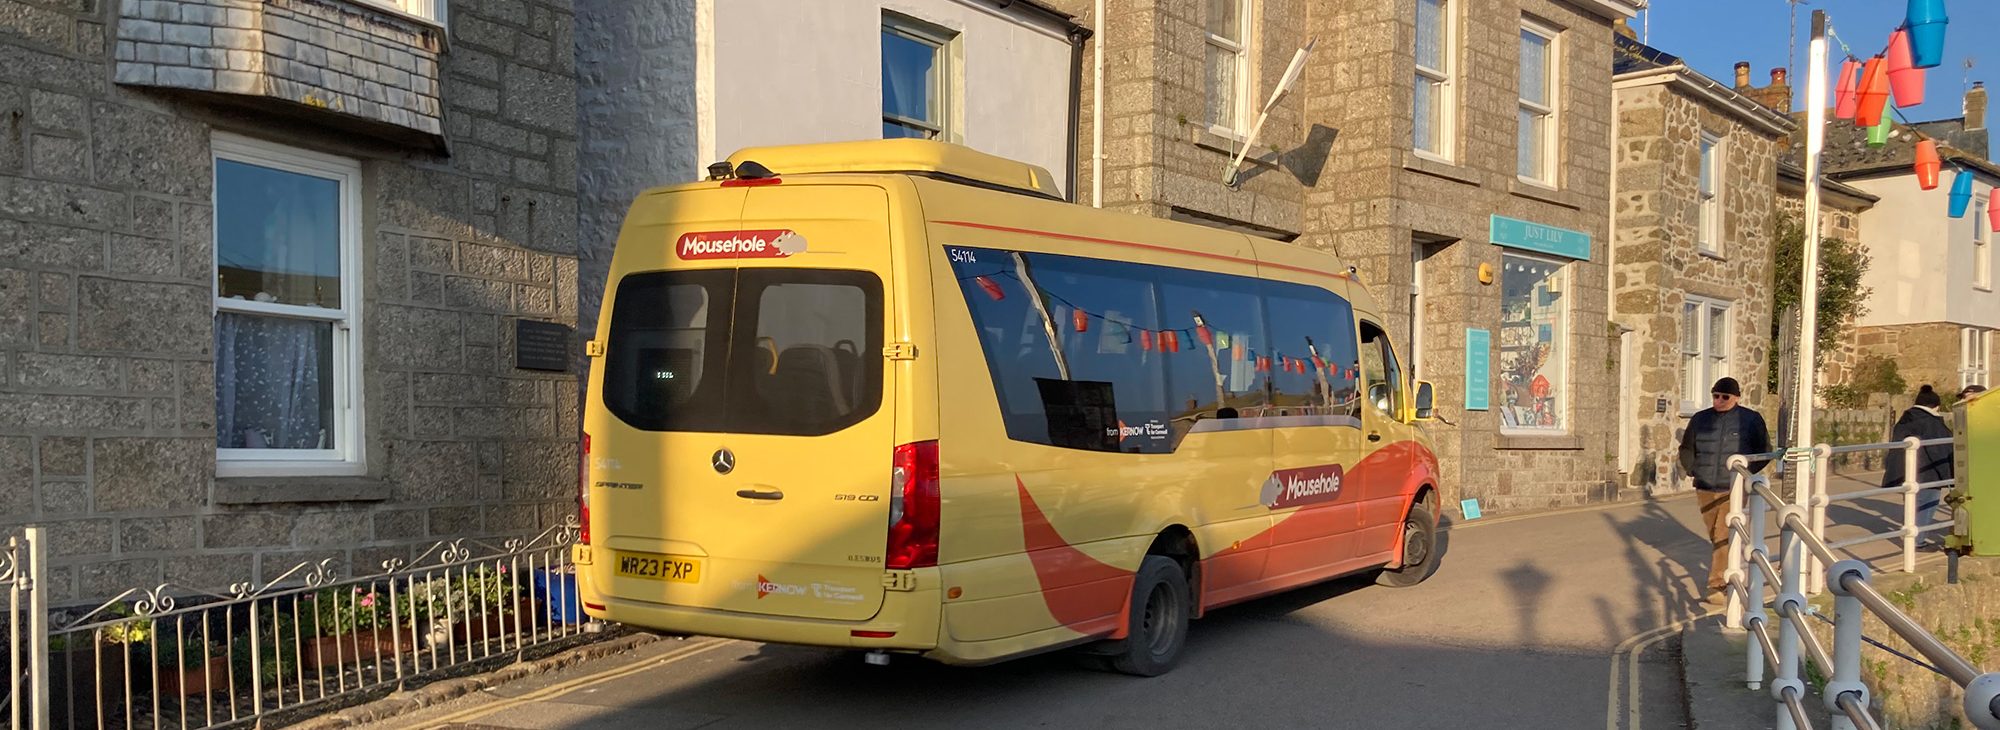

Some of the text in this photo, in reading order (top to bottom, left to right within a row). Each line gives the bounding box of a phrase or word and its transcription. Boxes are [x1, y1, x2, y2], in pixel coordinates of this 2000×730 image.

[1523, 225, 1564, 243] JUST LILY
[682, 235, 766, 256] Mousehole
[951, 248, 977, 264] 54114
[1106, 426, 1144, 437] from KERNOW
[1286, 471, 1340, 501] Mousehole
[621, 556, 693, 580] WR23 FXP
[758, 581, 807, 595] KERNOW
